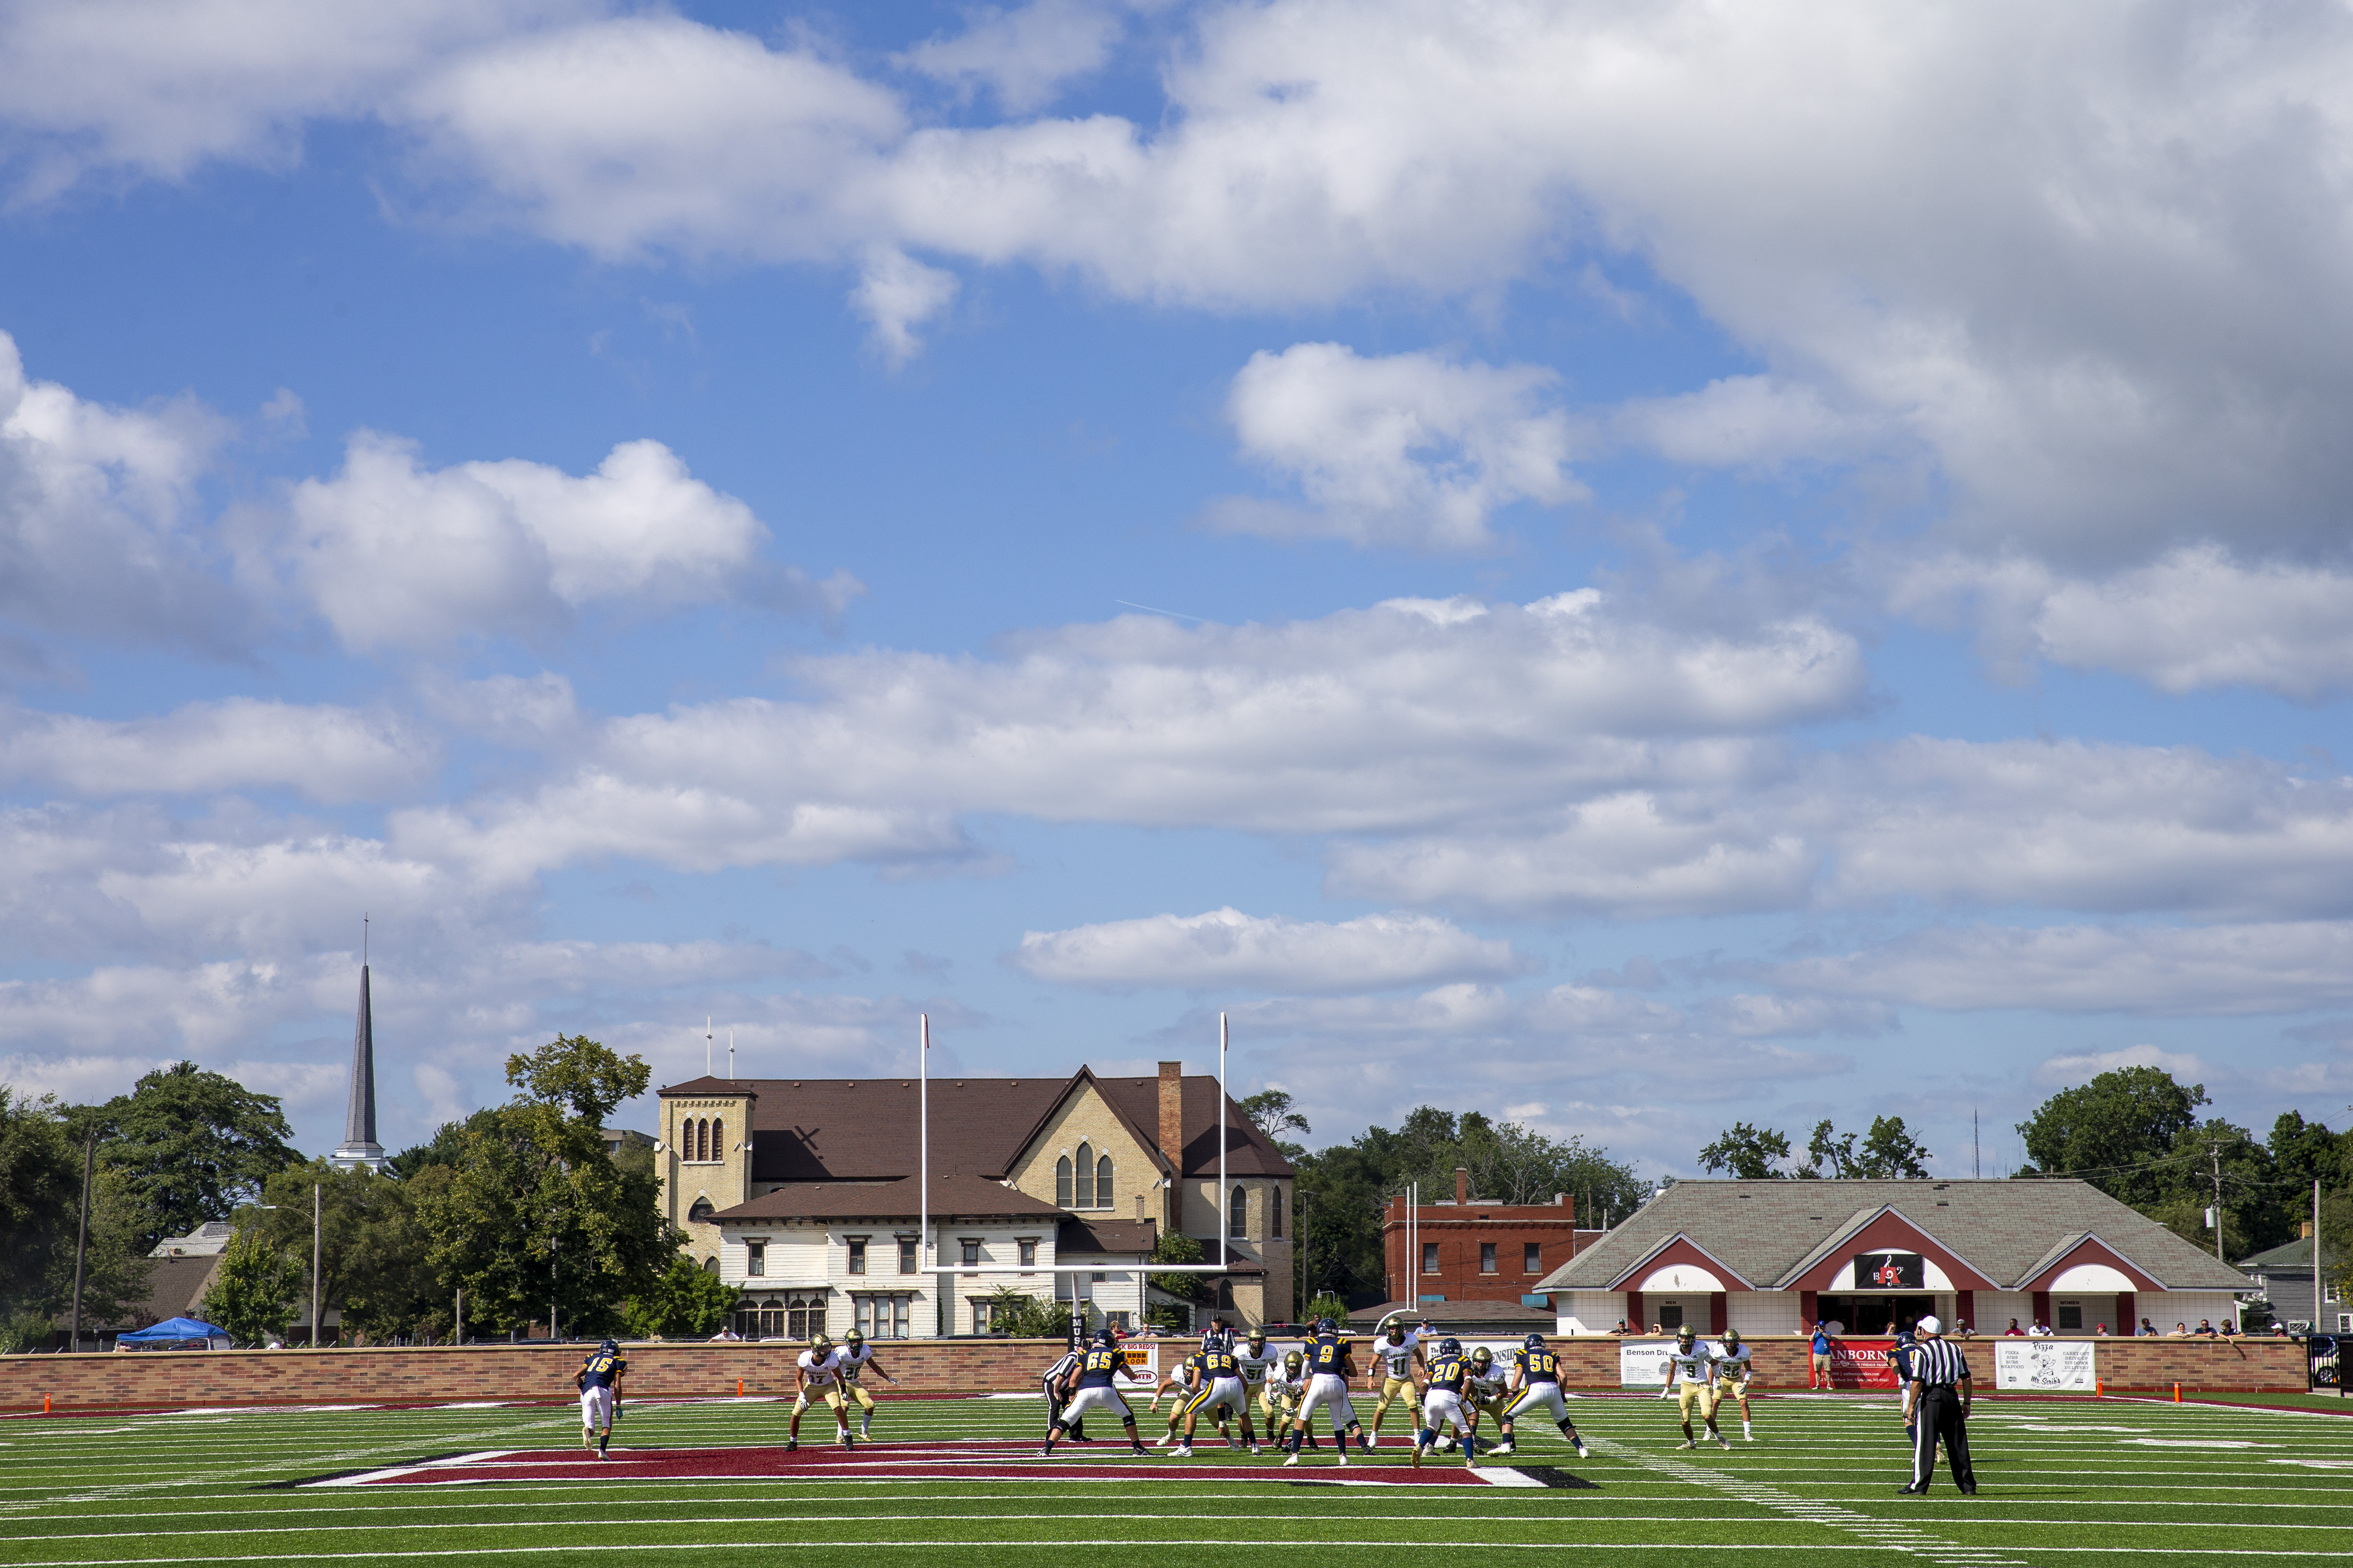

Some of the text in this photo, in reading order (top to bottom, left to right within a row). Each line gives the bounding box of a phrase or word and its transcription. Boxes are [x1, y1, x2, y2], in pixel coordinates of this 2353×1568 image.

[2032, 1341, 2054, 1352] Pizza
[1087, 1352, 1112, 1370] 65
[1319, 1345, 1333, 1363] 9
[587, 1357, 613, 1372] 15
[1207, 1354, 1231, 1369] 69
[1393, 1357, 1406, 1375] 11
[1529, 1354, 1553, 1372] 50
[845, 1367, 862, 1380] 20
[1246, 1368, 1263, 1380] 51
[1432, 1362, 1459, 1383] 20
[1686, 1364, 1696, 1378] 9
[1722, 1365, 1740, 1377] 22
[810, 1375, 826, 1384] 17
[2031, 1376, 2040, 1384] Mr.
